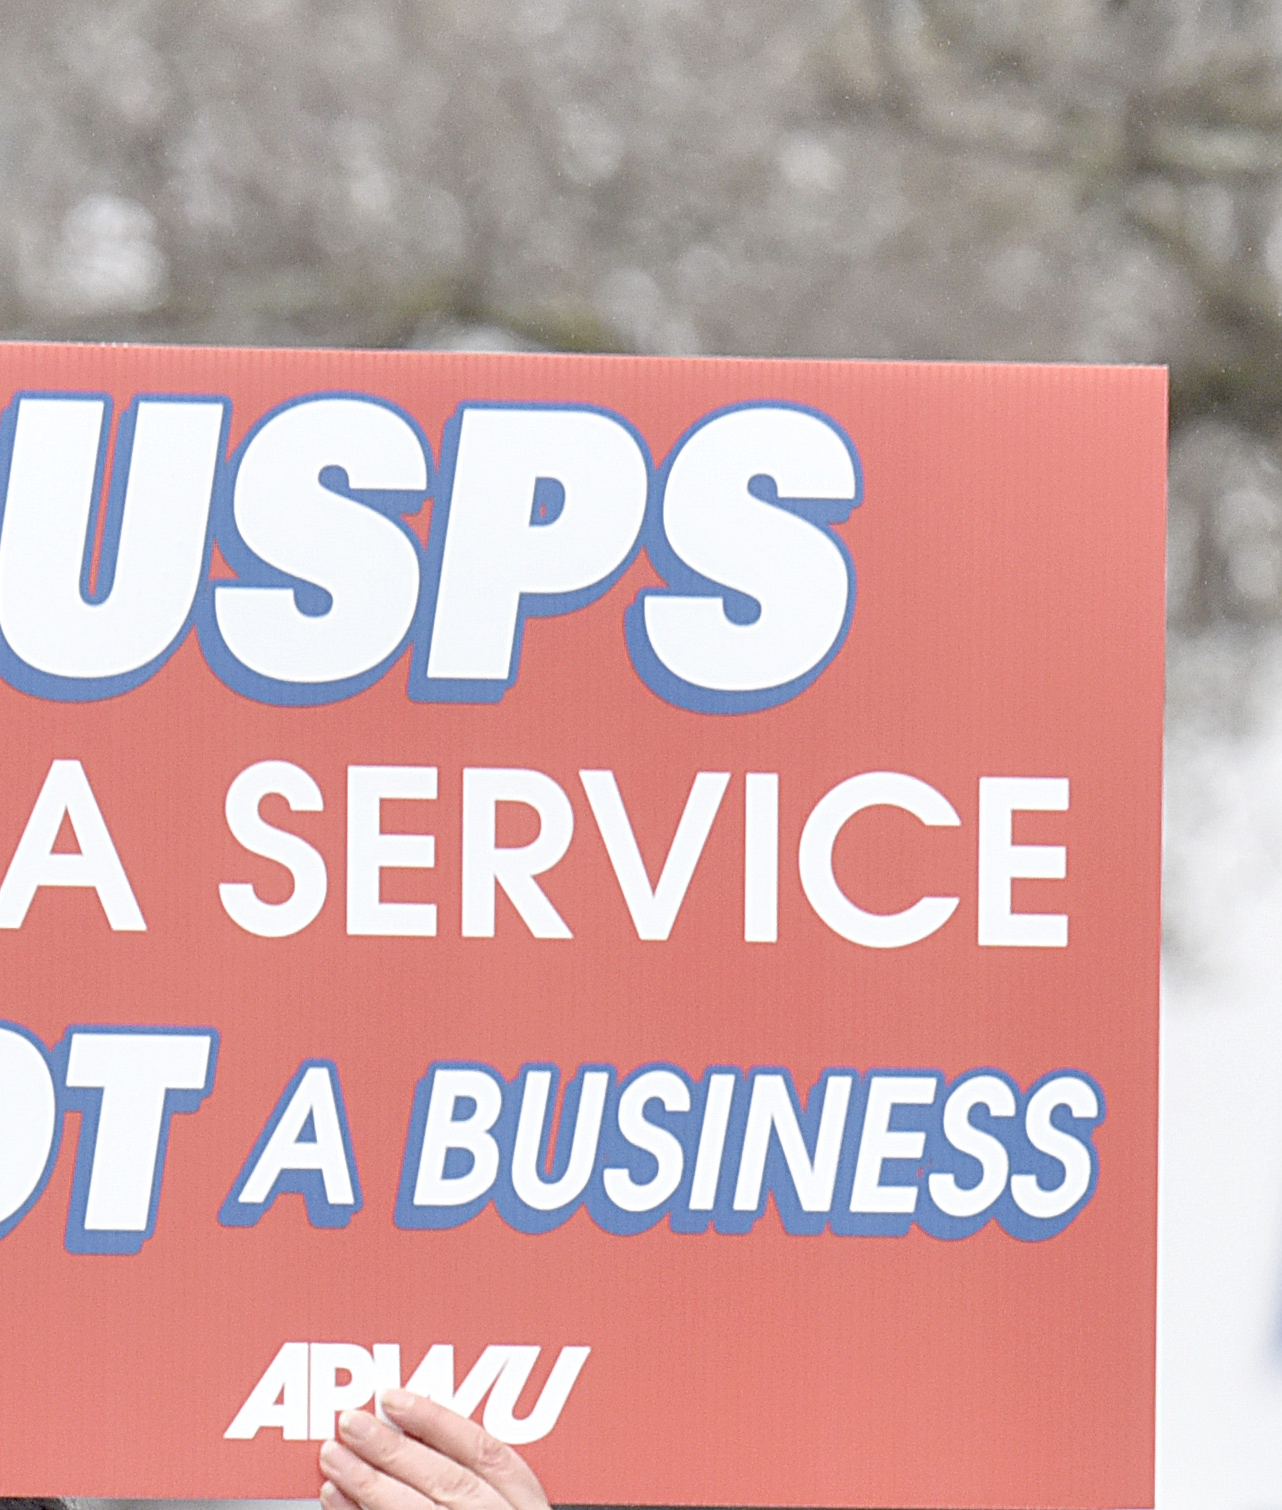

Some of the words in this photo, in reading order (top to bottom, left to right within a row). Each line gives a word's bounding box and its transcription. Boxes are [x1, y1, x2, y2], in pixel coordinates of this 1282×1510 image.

[218, 760, 1070, 948] SERVICE
[222, 1061, 361, 1226] A
[396, 1063, 1103, 1239] BUSINESS
